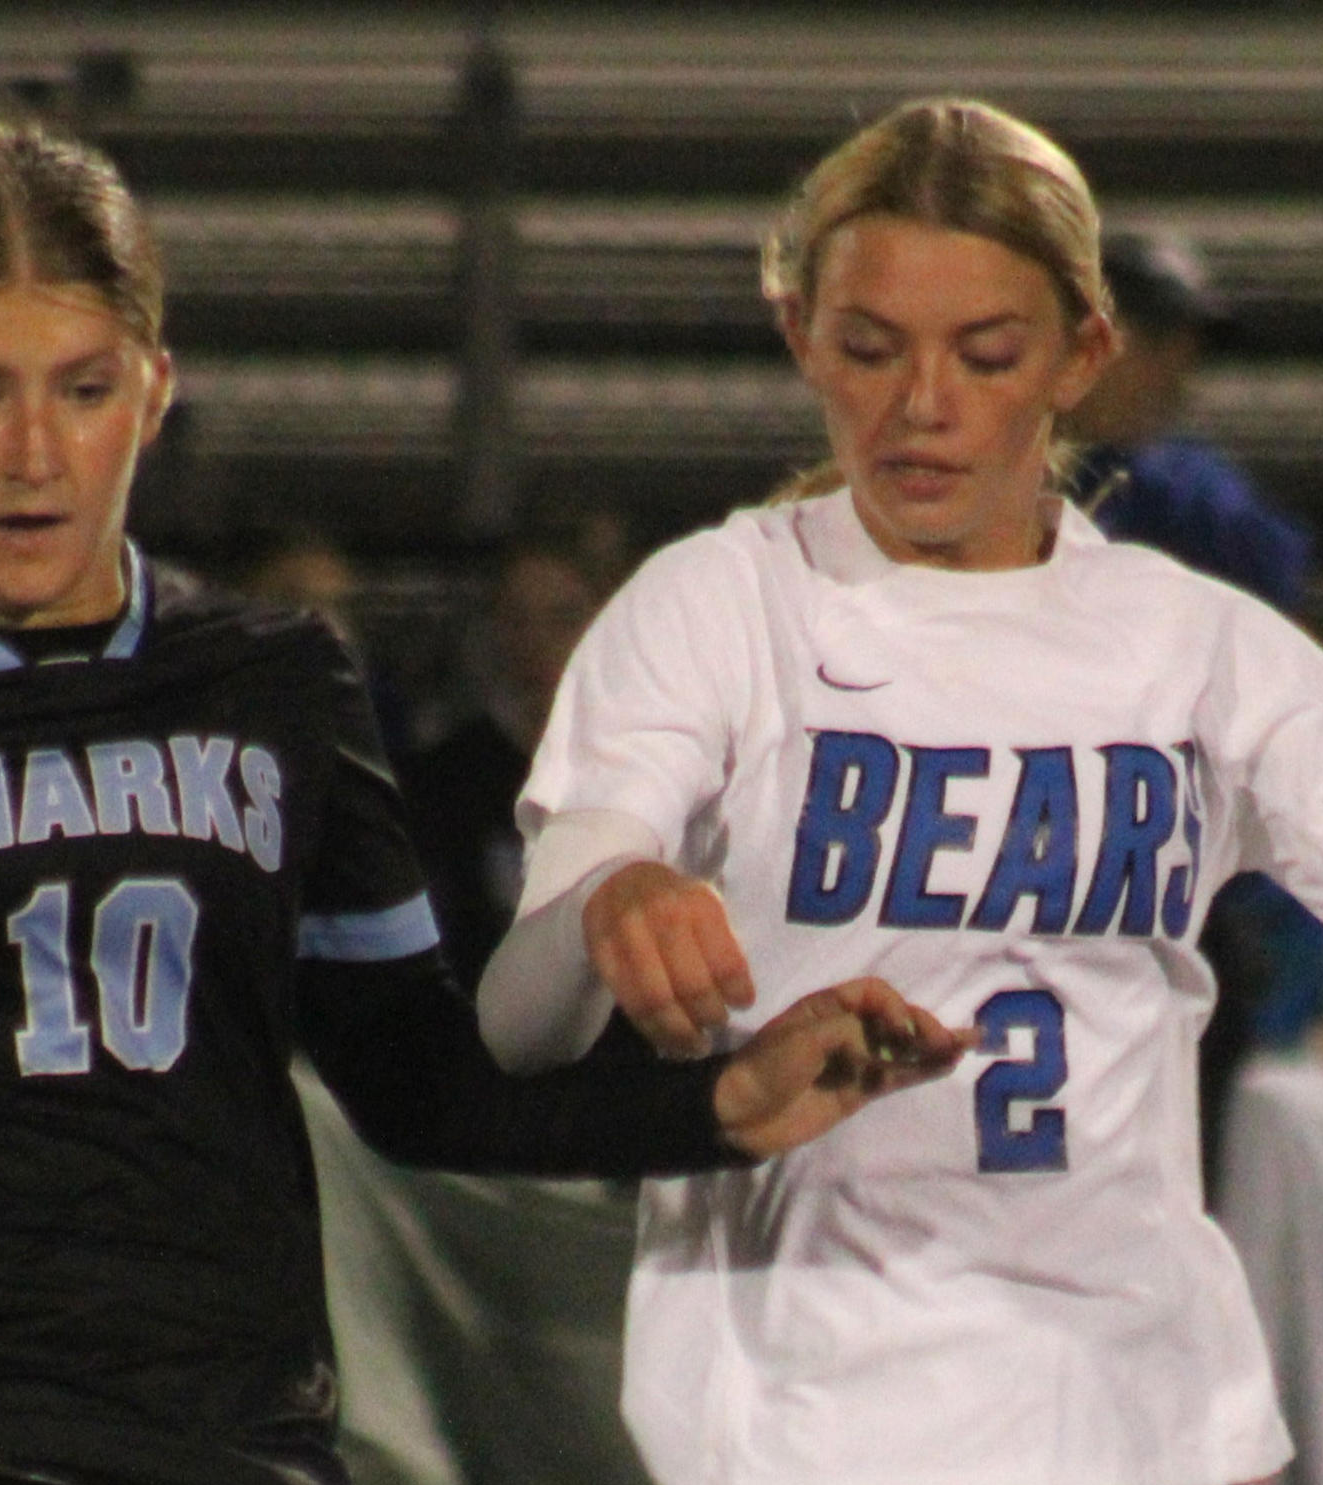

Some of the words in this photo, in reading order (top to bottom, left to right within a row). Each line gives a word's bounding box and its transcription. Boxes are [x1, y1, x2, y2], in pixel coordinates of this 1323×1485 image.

[785, 727, 1202, 939] BEARS
[7, 877, 199, 1077] 10
[974, 988, 1069, 1174] 2
